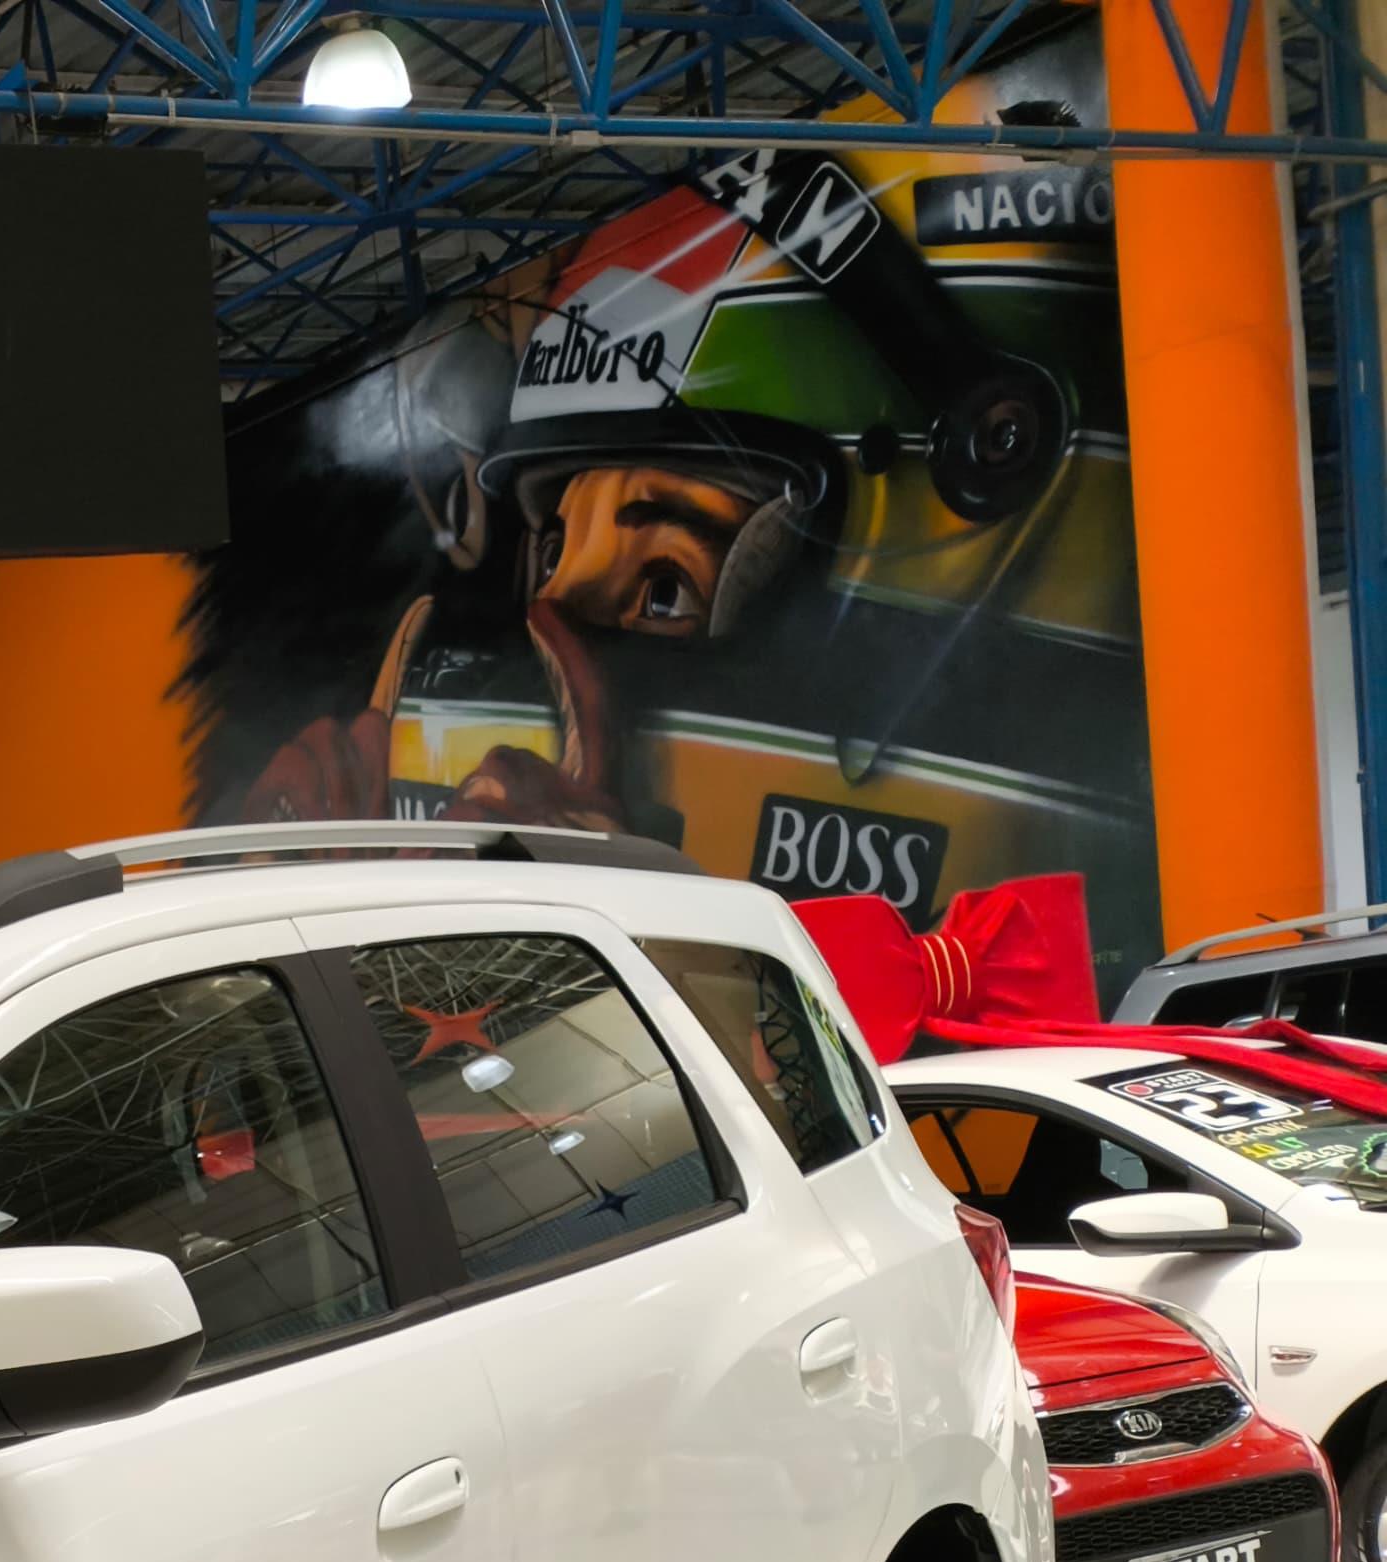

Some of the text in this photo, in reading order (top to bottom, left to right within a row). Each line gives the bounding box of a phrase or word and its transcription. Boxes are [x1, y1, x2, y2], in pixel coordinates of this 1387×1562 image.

[517, 303, 665, 388] Marlboro
[761, 805, 931, 909] BOSS
[1152, 1083, 1292, 1125] 23
[1125, 1411, 1159, 1435] KIA
